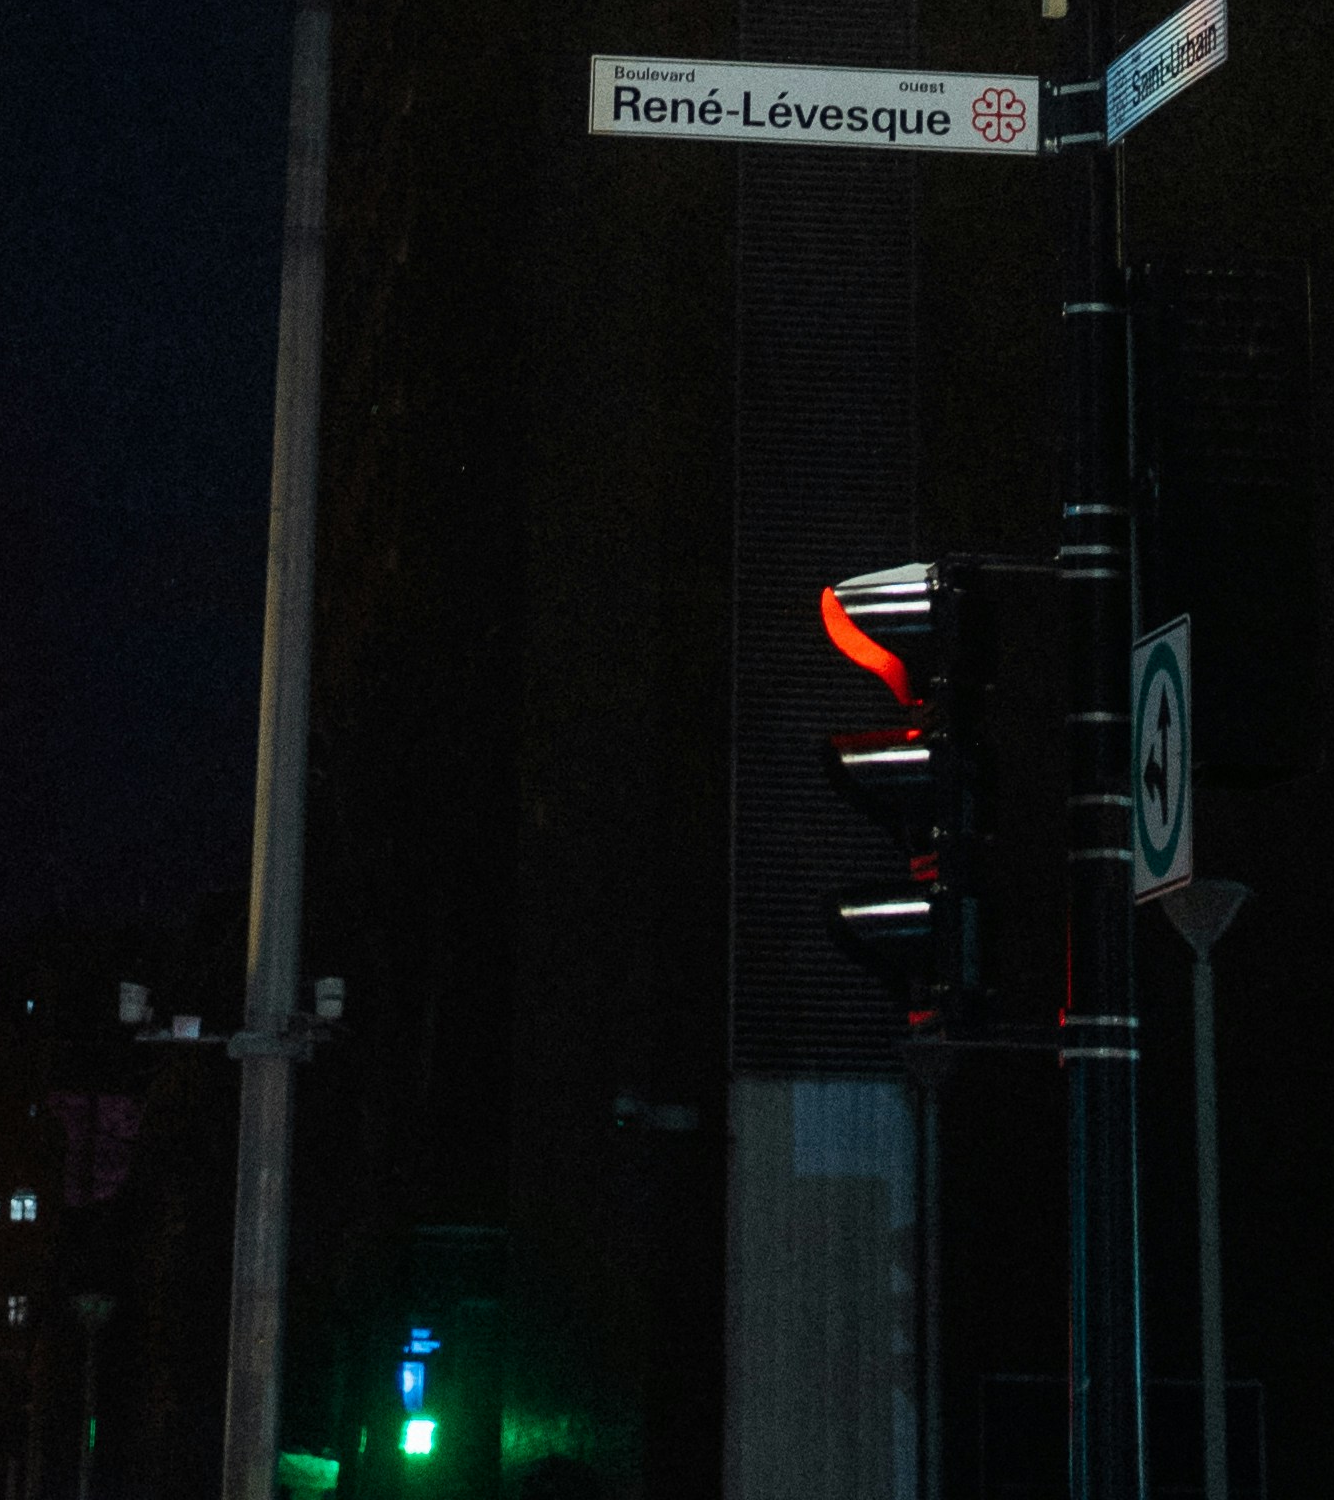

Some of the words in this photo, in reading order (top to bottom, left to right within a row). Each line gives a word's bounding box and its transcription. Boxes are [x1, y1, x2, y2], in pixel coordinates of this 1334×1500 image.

[614, 65, 696, 83] Boulevard
[1132, 19, 1218, 106] Saint-Urbain
[898, 81, 945, 94] ouest
[613, 85, 951, 142] René-Lévesque
